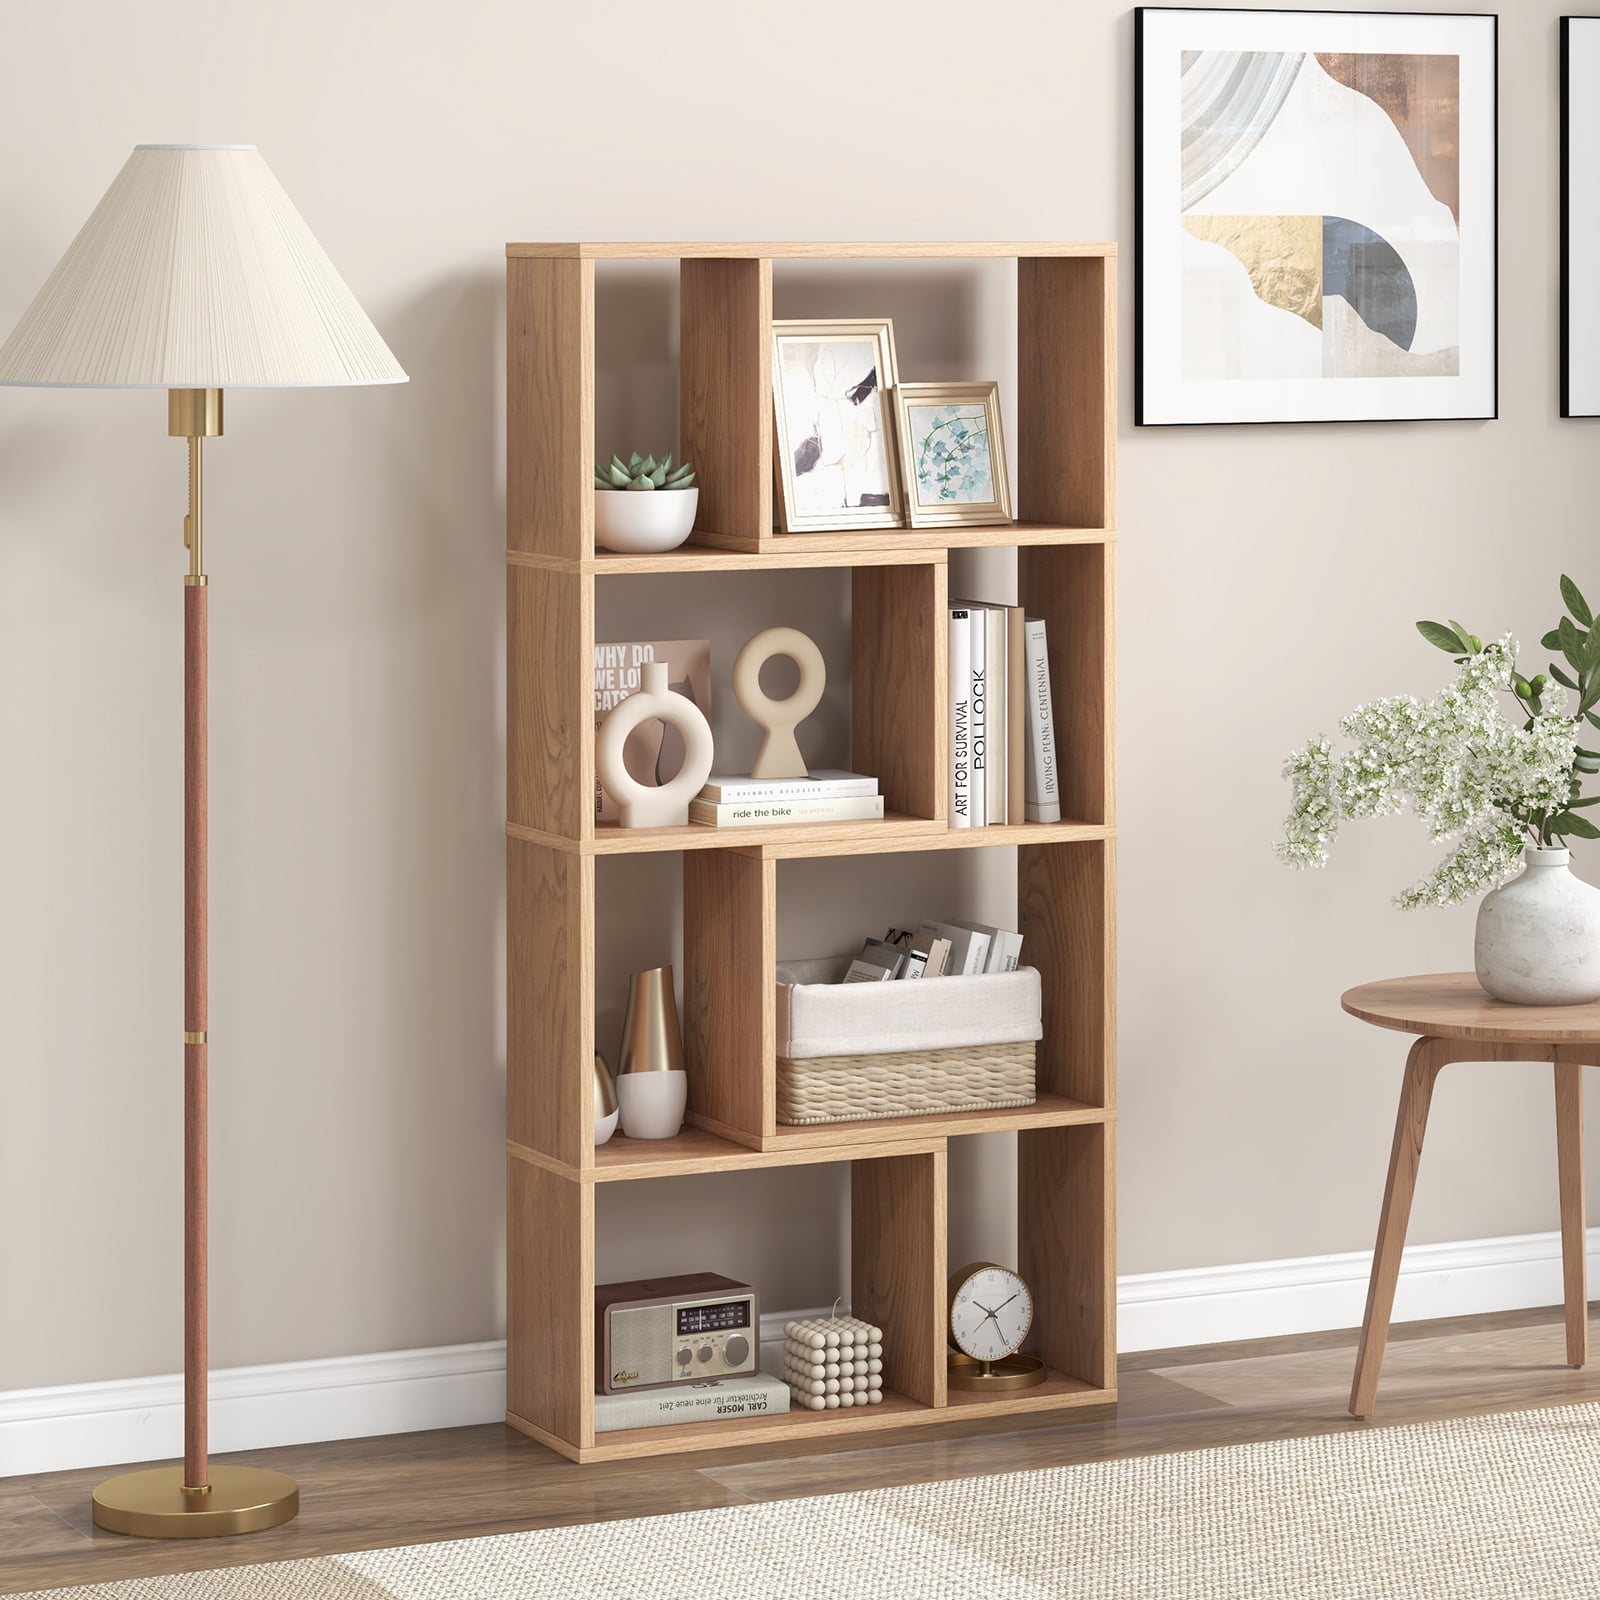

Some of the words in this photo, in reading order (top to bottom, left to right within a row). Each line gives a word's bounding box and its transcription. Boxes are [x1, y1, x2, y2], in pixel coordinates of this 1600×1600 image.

[595, 645, 627, 668] WHY
[632, 644, 654, 667] DO
[595, 669, 615, 690] WE
[1036, 656, 1049, 721] CENTENNIAL
[955, 700, 968, 758] SURVIVAL
[973, 670, 985, 770] POLLOCK
[1041, 723, 1052, 753] PENN:
[955, 762, 968, 788] FOR
[1043, 756, 1055, 795] IRVING
[733, 809, 752, 819] ride
[754, 808, 770, 818] the
[772, 807, 792, 817] bike
[955, 792, 968, 817] ART
[659, 1401, 674, 1411] Zeit
[675, 1399, 694, 1408] neue
[695, 1397, 712, 1406] eine
[713, 1394, 725, 1406] für
[716, 1403, 745, 1414] MOSER
[725, 1392, 768, 1404] Architektur
[748, 1401, 768, 1411] CARL
